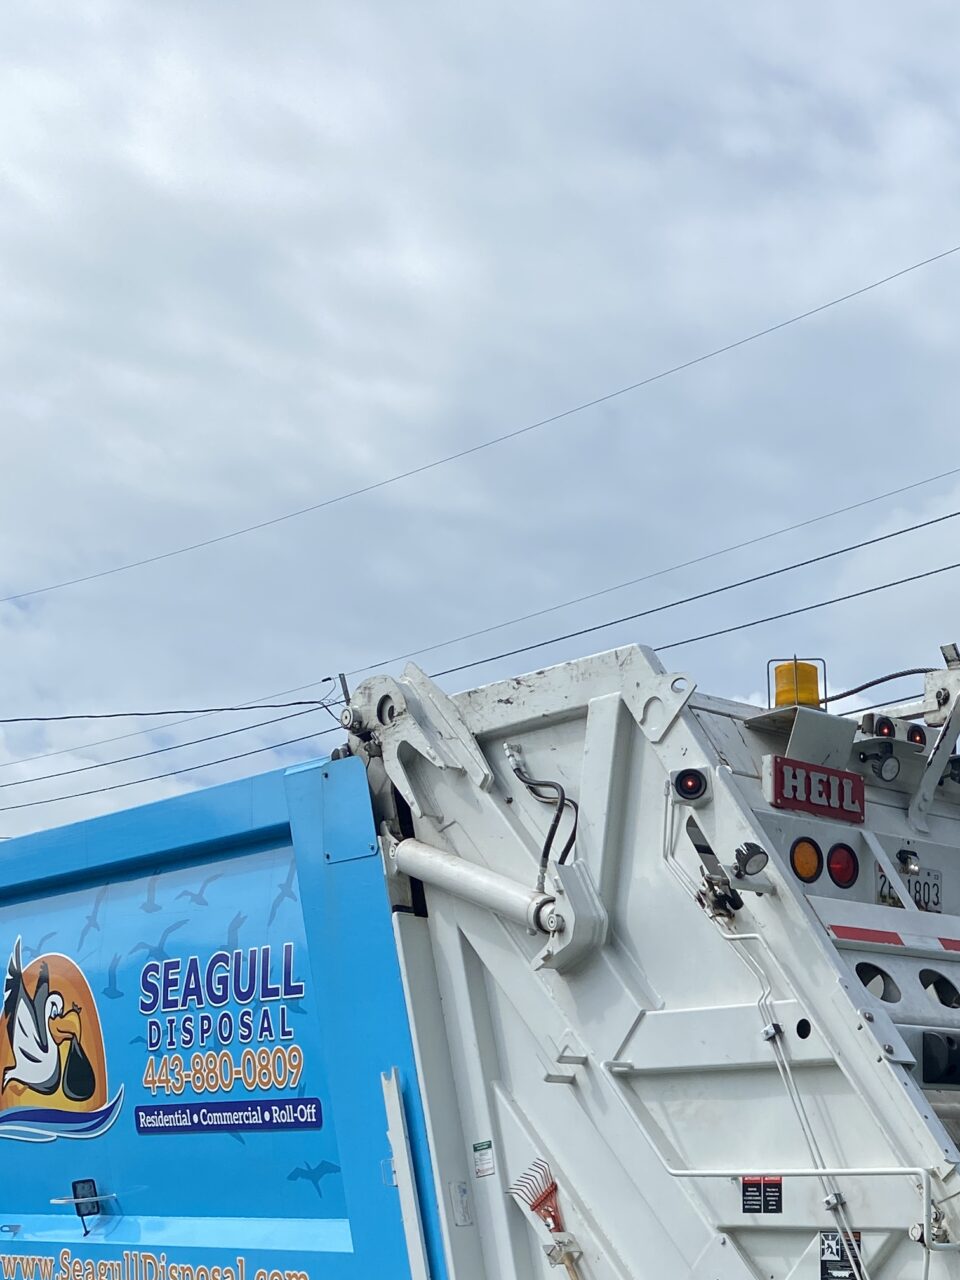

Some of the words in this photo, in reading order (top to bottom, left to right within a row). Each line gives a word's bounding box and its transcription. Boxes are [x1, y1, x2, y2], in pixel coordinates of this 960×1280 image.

[783, 765, 861, 812] HEIL
[879, 874, 940, 906] 2E1803
[140, 942, 304, 1014] SEAGULL
[148, 1005, 294, 1050] DISPOSAL
[143, 1045, 303, 1095] 443-880-0809
[139, 1109, 191, 1128] Residential
[200, 1106, 262, 1126] Commercial
[271, 1103, 316, 1123] Roll-Off
